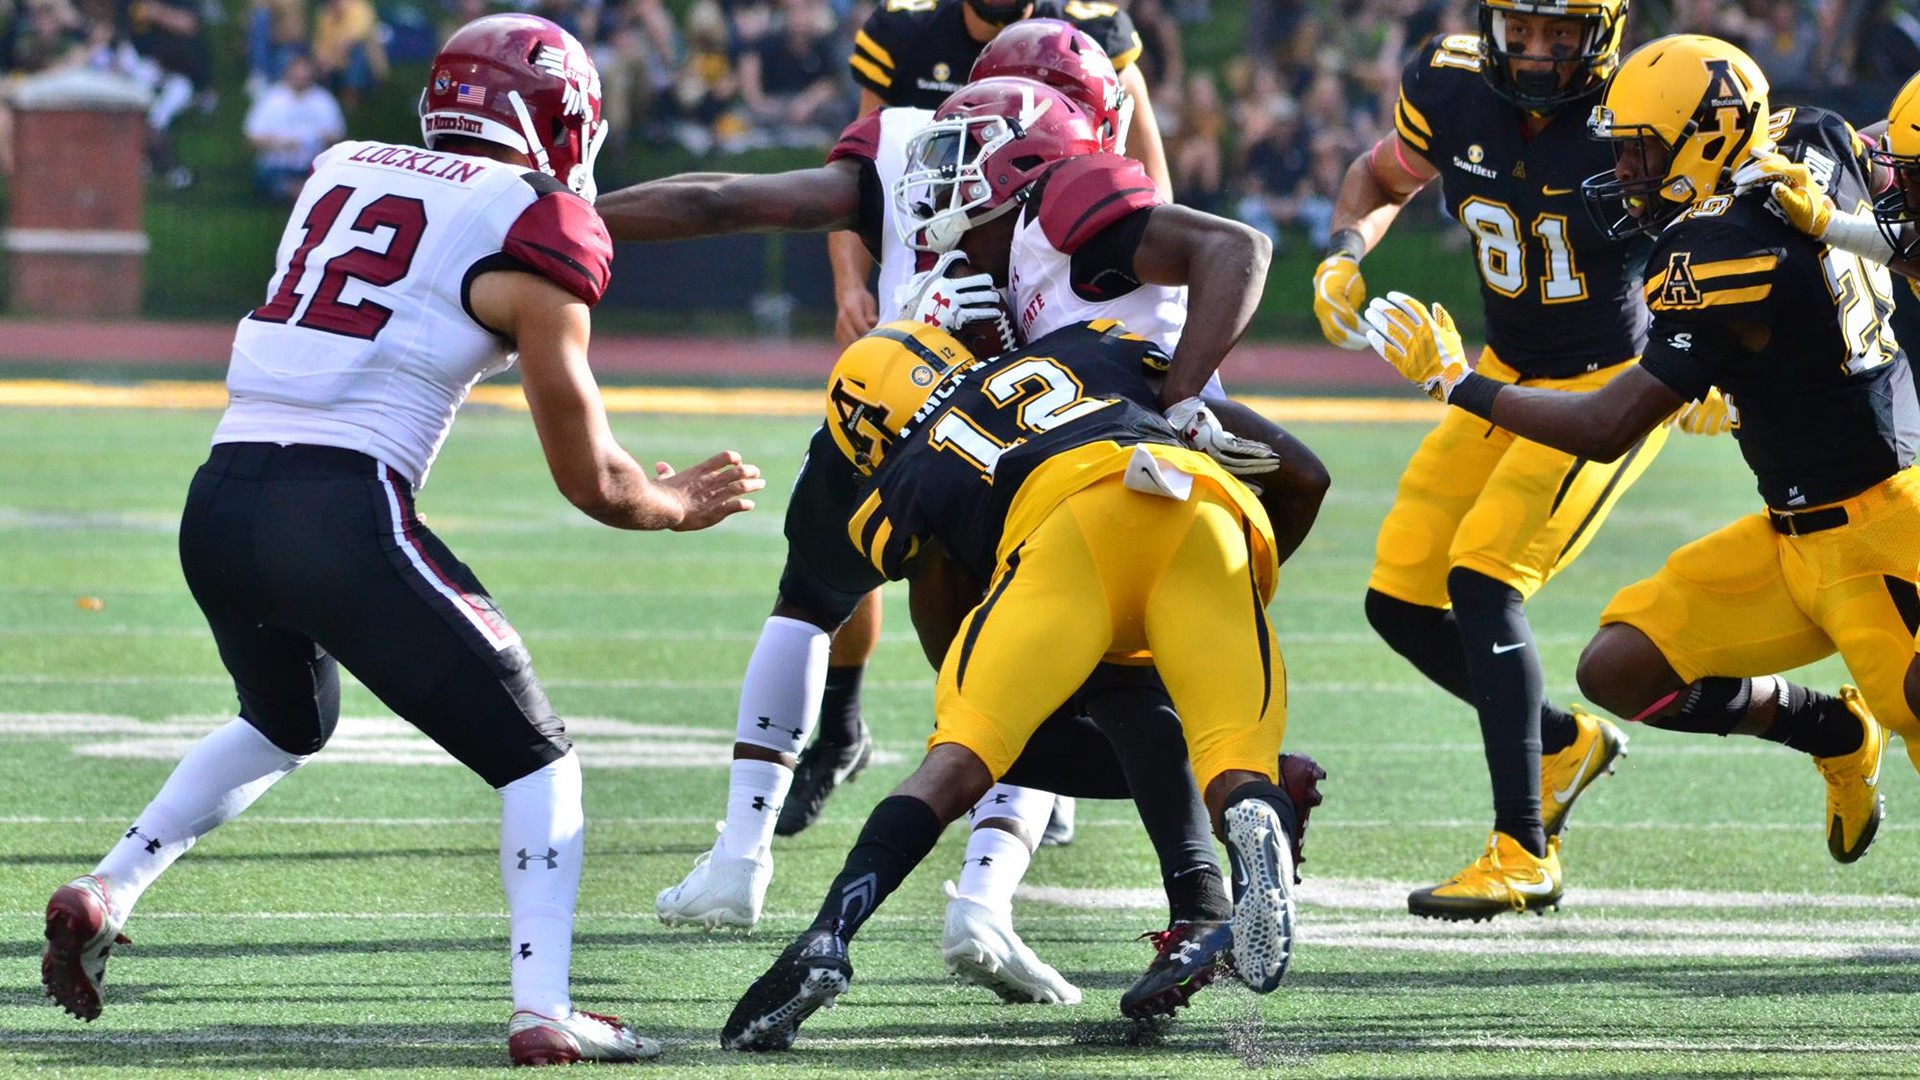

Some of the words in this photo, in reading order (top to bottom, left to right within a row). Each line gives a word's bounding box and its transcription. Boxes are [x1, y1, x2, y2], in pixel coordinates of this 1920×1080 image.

[349, 146, 486, 183] LOCKLIN
[248, 185, 428, 342] 12
[1459, 194, 1590, 305] 81
[1661, 252, 1701, 304] A
[940, 346, 956, 360] 12
[928, 357, 1121, 486] 12
